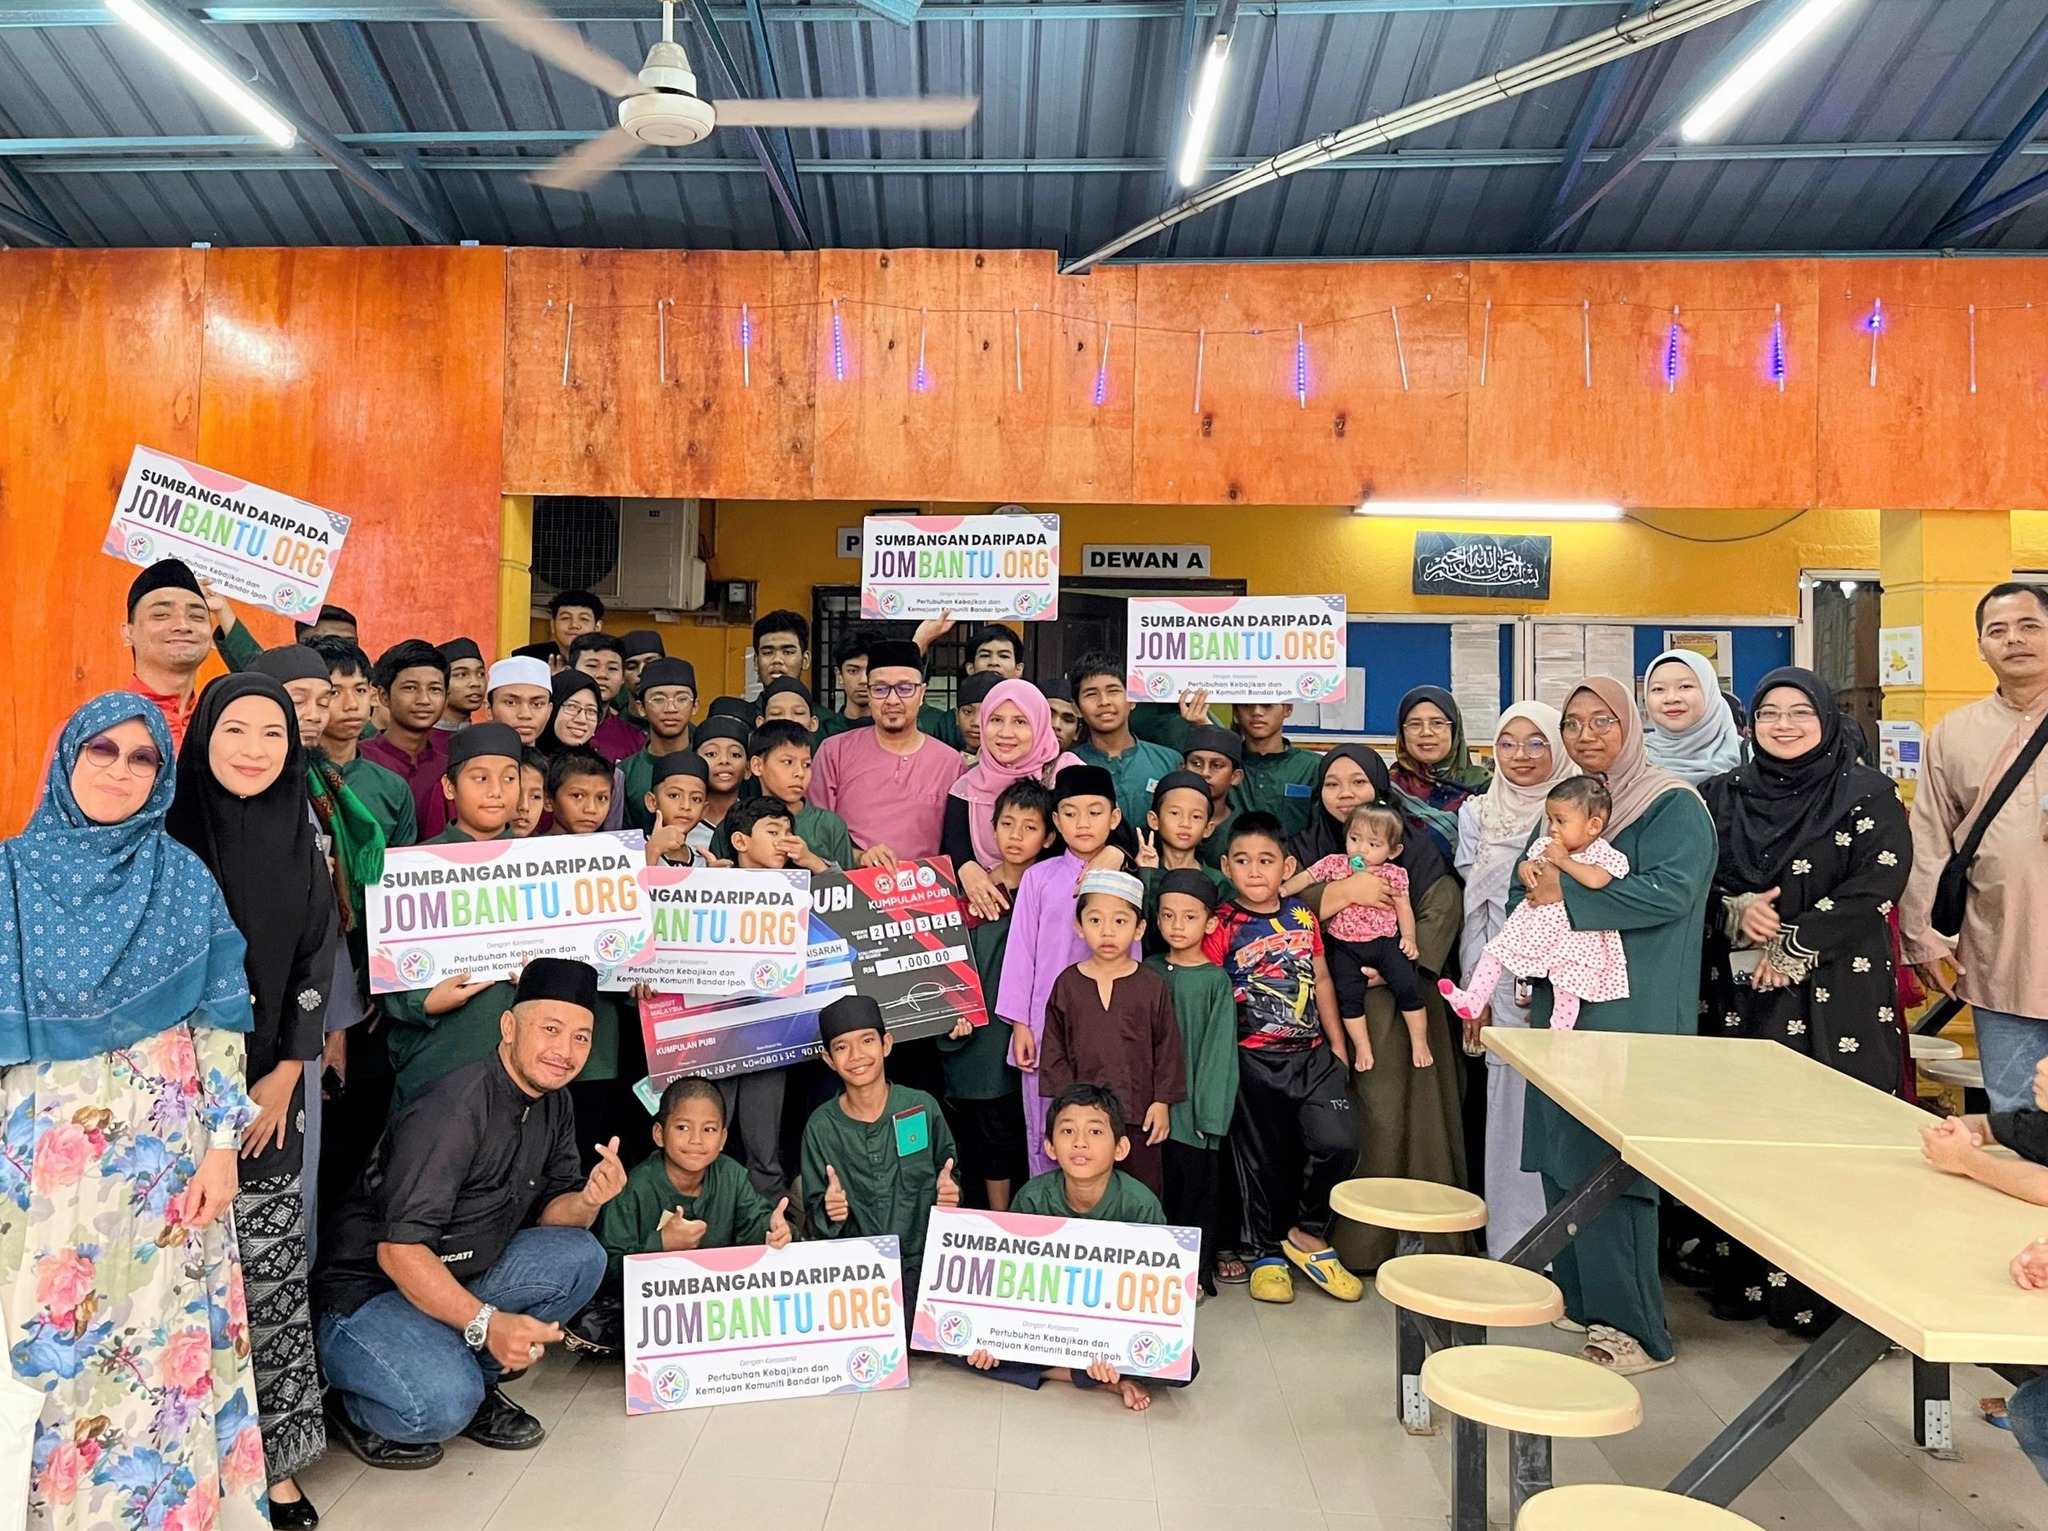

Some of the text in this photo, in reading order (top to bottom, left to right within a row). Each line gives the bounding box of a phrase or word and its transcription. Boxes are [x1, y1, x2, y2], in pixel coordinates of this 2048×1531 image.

[141, 469, 329, 544] SUMBANGAN DARIPADA
[124, 485, 328, 578] JOMBANTU.ORG
[875, 533, 1047, 546] SUMBANGAN DARIPADA
[846, 536, 860, 551] P
[870, 550, 1049, 578] JOMBANTU.ORG
[1090, 551, 1204, 569] DEWAN A
[209, 565, 244, 583] Kebajikan
[246, 580, 260, 589] dan
[224, 581, 250, 594] Bandar
[251, 590, 267, 600] Ipoh
[1140, 614, 1332, 628] SUMBANGAN DARIPADA
[1135, 630, 1336, 660] JOMBANTU.ORG
[383, 854, 631, 889] SUMBANGAN DARIPADA
[379, 874, 638, 934] JOMBANTU.ORG
[648, 888, 794, 906] NGAN DARIPADA
[808, 884, 854, 914] UBI
[868, 892, 925, 910] KUMPULAN
[927, 888, 950, 899] PUBI
[653, 907, 796, 946] ANTU.ORG
[454, 945, 577, 963] Pertubuhan Kebajikan dan
[896, 950, 950, 970] 1,000.00
[442, 962, 524, 975] Kemajuan Komun
[676, 968, 717, 976] Kebajikan
[863, 966, 876, 974] RM
[660, 977, 694, 985] Komuniti
[727, 979, 745, 987] Ipoh
[656, 1037, 716, 1055] KUMPULAN PUBI
[440, 1250, 473, 1262] UCATI
[942, 1232, 1181, 1269] SUMBANGAN DARIPADA
[641, 1263, 886, 1298] SUMBANGAN DARIPADA
[929, 1253, 1182, 1315] JOMBANTU.ORG
[637, 1286, 891, 1349] JOMBANTU.ORG
[990, 1328, 1109, 1348] Pertubuhan Kebajikan dan
[976, 1338, 1021, 1350] Kemajuan
[1024, 1343, 1063, 1355] Komuniti
[1065, 1347, 1098, 1359] Bandar
[708, 1364, 829, 1382] Pertubuhan Kebajikan dan
[695, 1374, 842, 1396] Kemajuan Komuniti Bandar Ipoh
